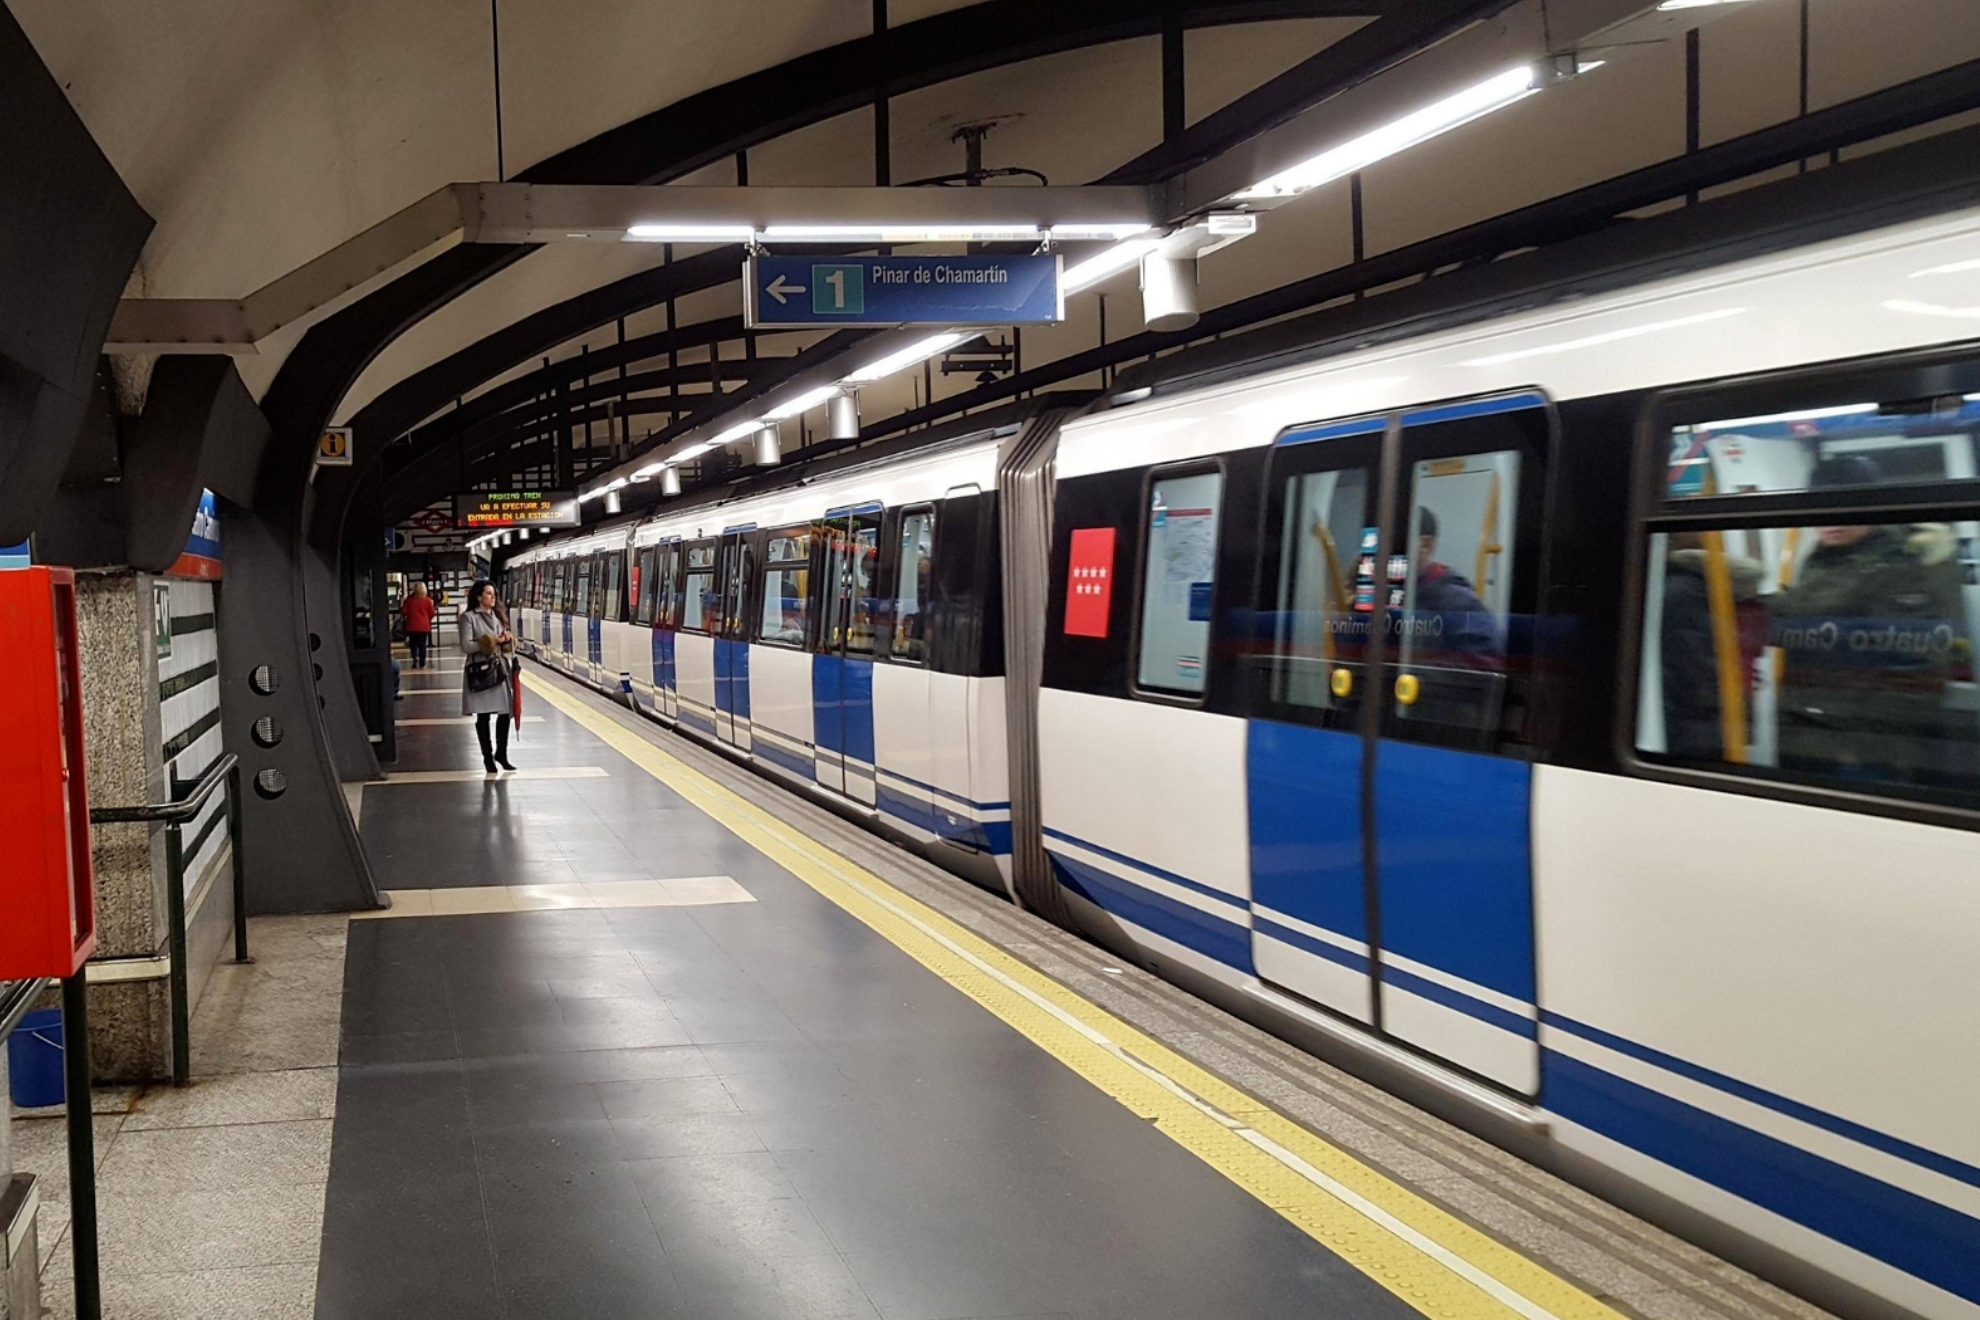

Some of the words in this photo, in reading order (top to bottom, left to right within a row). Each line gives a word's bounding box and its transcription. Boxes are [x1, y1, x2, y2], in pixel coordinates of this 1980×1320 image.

[825, 270, 845, 308] 1
[872, 265, 910, 284] Pinar
[913, 265, 931, 284] de
[935, 264, 1008, 284] Chamartín
[488, 492, 520, 501] PROXIMO
[523, 492, 541, 500] TREN
[480, 503, 490, 511] VA
[502, 502, 537, 510] EFECTUAR
[541, 501, 551, 509] SU
[467, 513, 499, 521] ENTRADA
[502, 512, 513, 520] EN
[515, 512, 525, 520] LA
[528, 511, 564, 520] ESTACION
